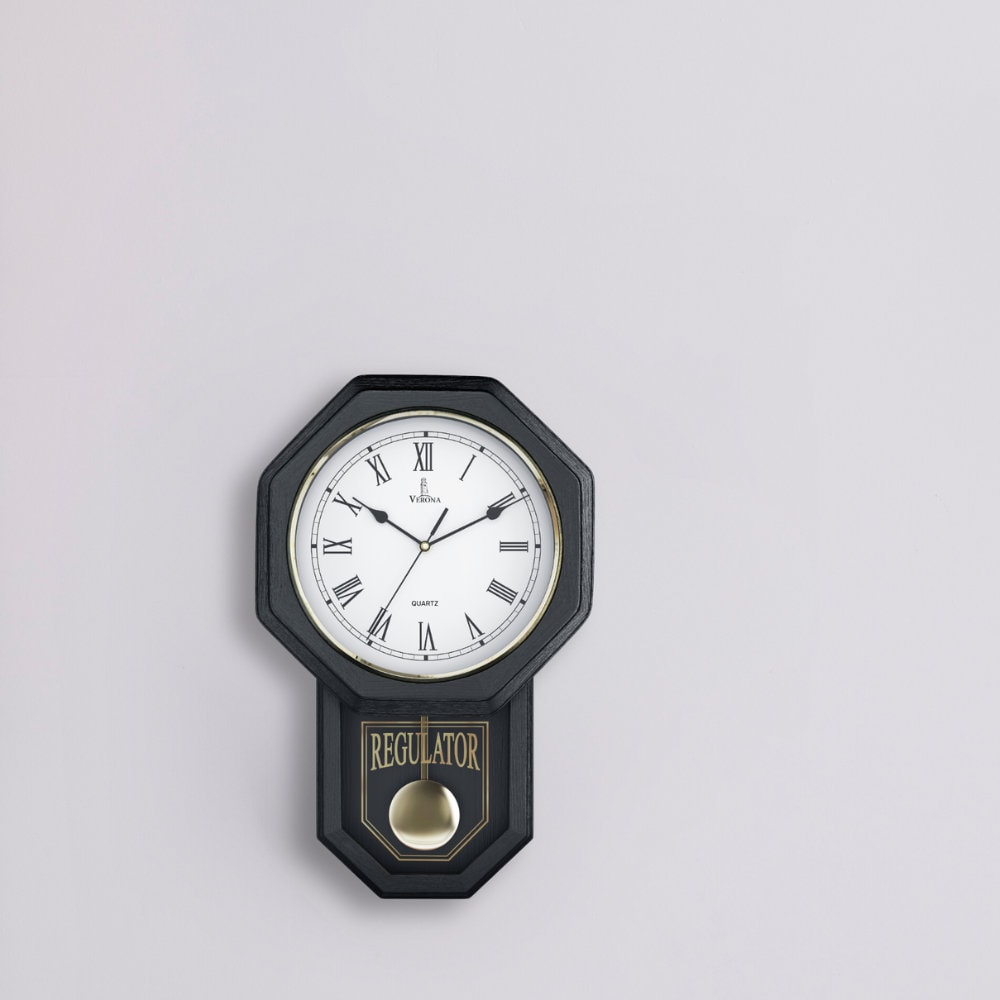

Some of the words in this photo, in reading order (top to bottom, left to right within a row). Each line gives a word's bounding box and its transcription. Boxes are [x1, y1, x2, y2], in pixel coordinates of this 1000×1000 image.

[365, 454, 392, 486] XI
[413, 442, 434, 471] XII
[459, 454, 476, 481] I
[332, 492, 362, 516] X
[323, 537, 352, 555] IX
[499, 540, 529, 552] III
[332, 574, 364, 610] VIII
[486, 578, 519, 605] IIII
[367, 607, 392, 642] VII
[418, 622, 437, 651] VI
[464, 612, 485, 640] V
[369, 731, 481, 771] REGULATOR
